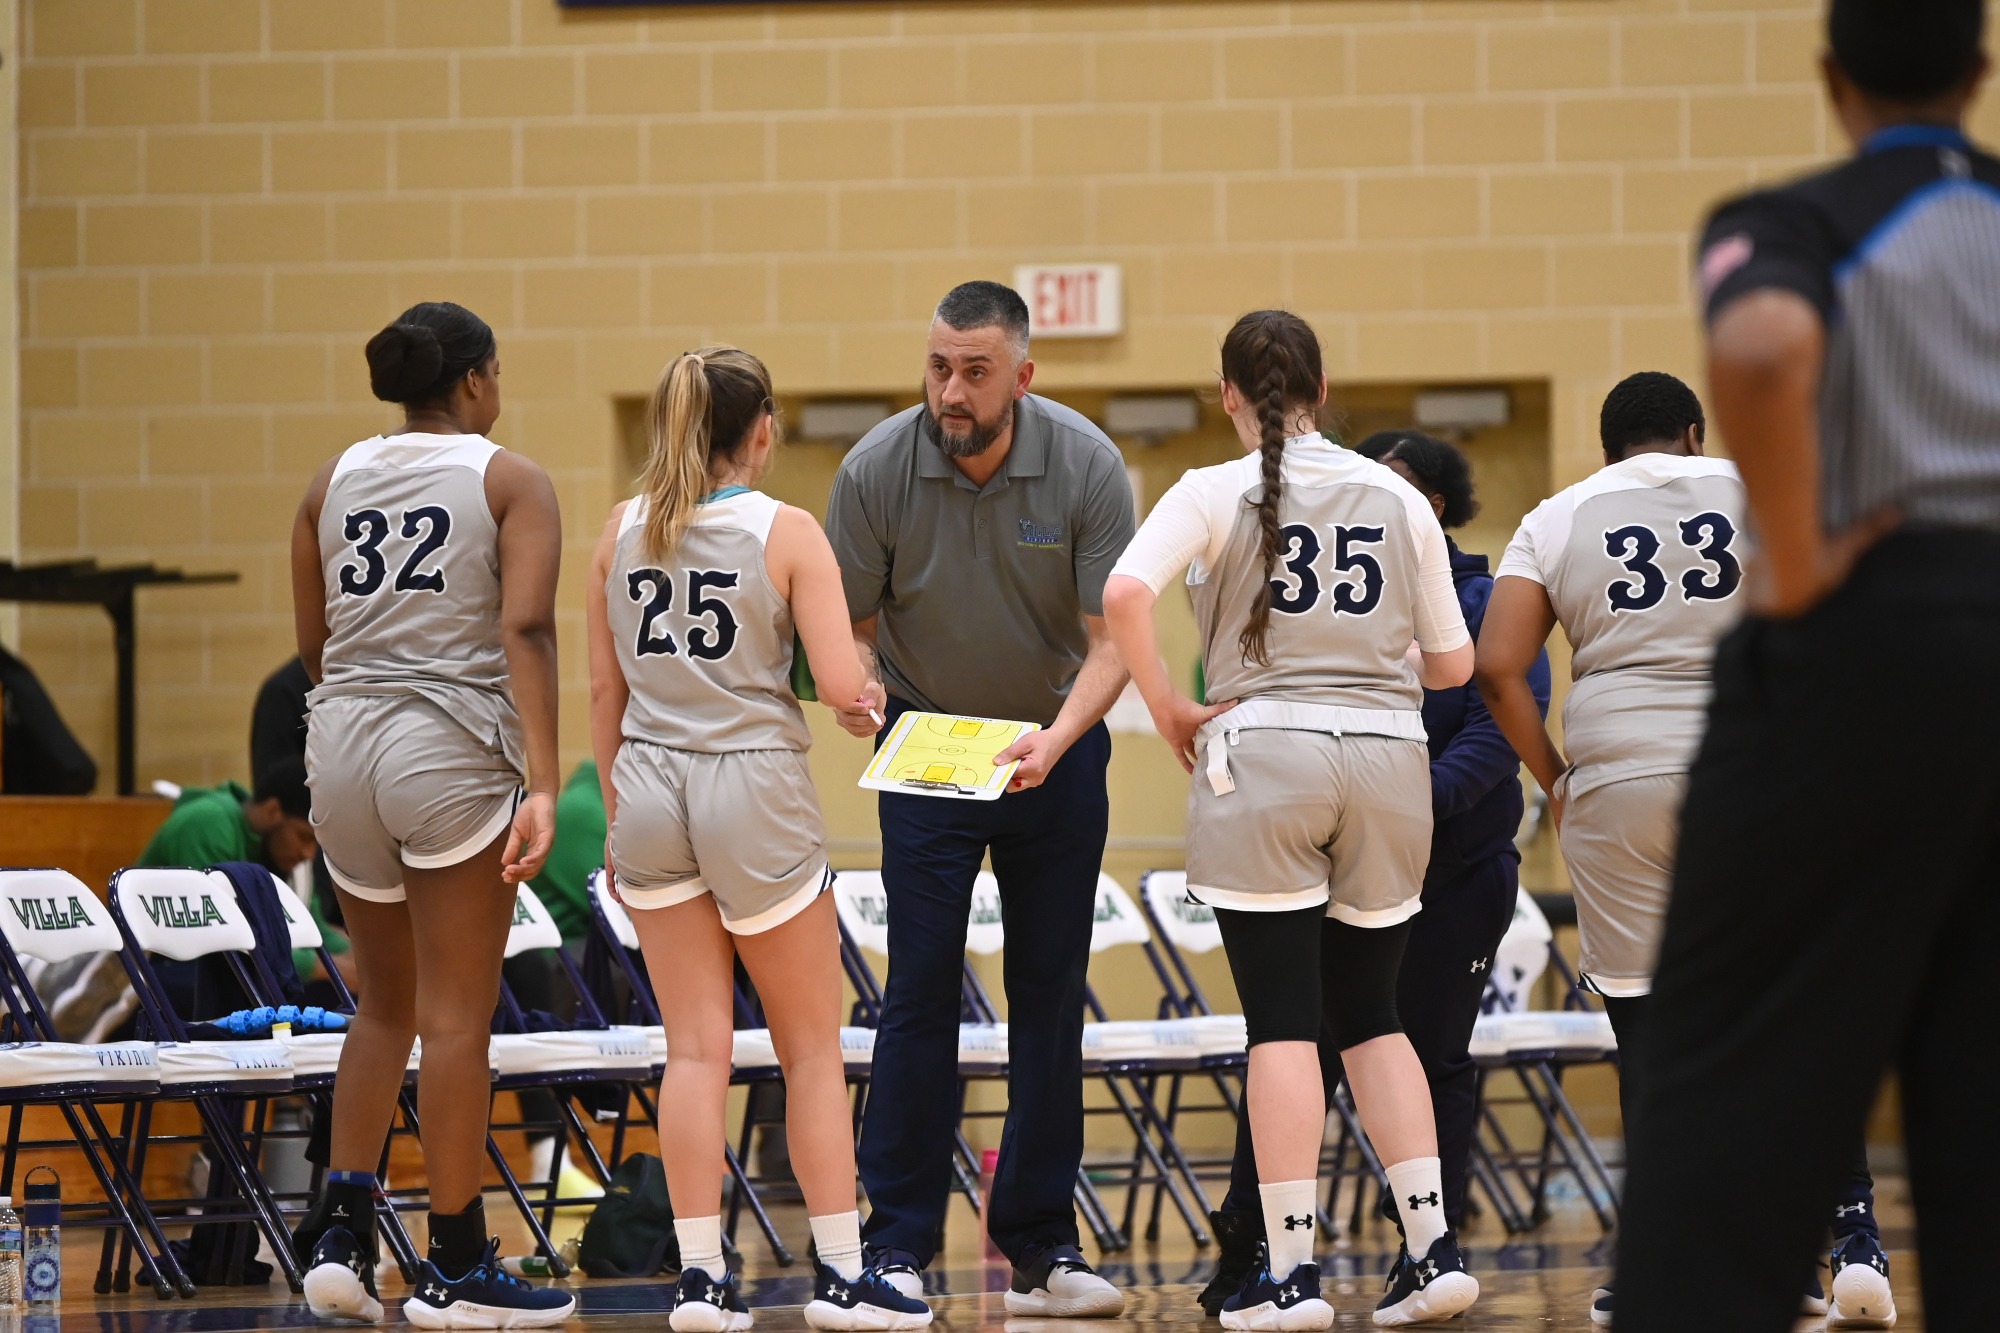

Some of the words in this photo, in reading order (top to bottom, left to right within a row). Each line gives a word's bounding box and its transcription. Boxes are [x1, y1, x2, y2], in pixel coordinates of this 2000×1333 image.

[1034, 270, 1102, 327] EXIT
[339, 504, 453, 597] 32
[1269, 522, 1388, 618] 35
[1603, 509, 1747, 617] 33
[626, 566, 743, 663] 25
[7, 896, 95, 930] VILLA
[137, 894, 229, 928] VILLA
[96, 1050, 158, 1067] VIKING
[458, 1304, 478, 1312] FLOW
